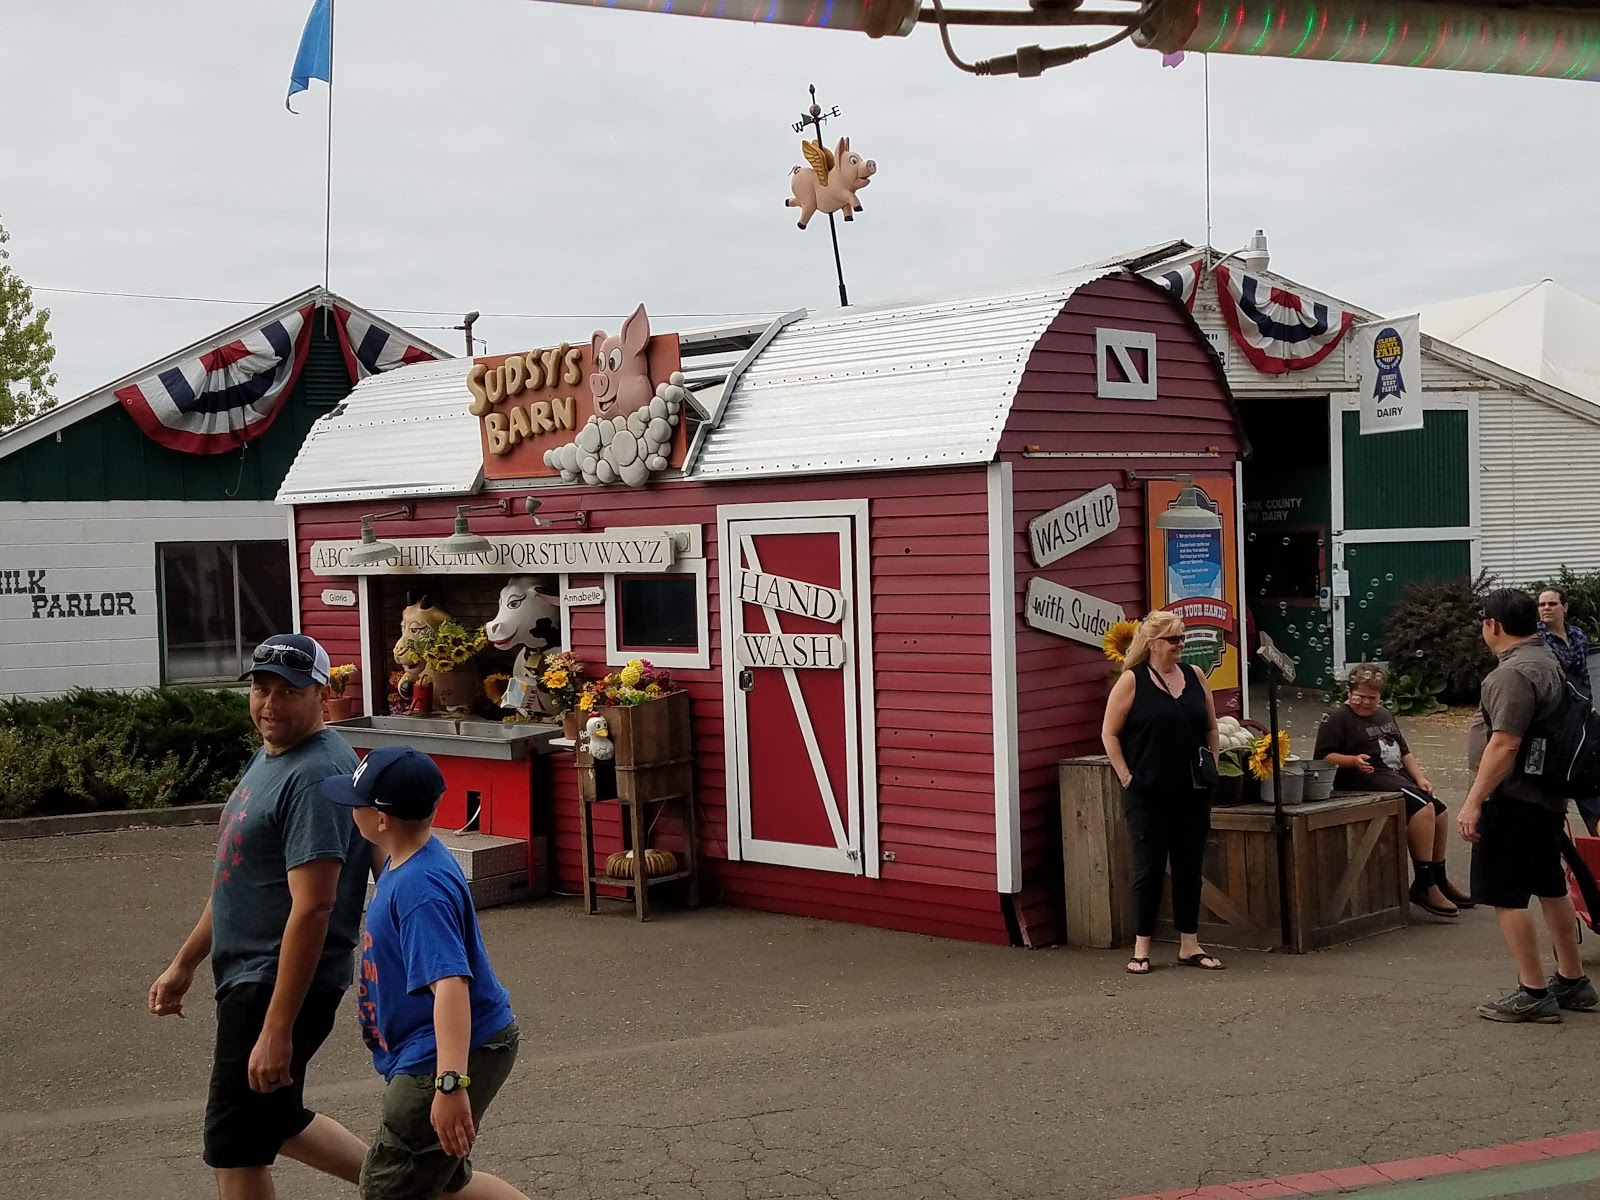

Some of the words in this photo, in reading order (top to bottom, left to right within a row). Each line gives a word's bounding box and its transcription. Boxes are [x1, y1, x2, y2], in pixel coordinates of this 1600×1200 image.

[1376, 341, 1398, 350] COUNTY
[1377, 336, 1397, 345] CLARK
[1376, 346, 1401, 358] FAIR
[466, 342, 582, 417] SUDSY'S
[1376, 406, 1403, 418] DAIRY
[485, 396, 577, 455] BARN
[1266, 497, 1302, 509] COUNTY
[1036, 505, 1089, 556] WASH
[1093, 494, 1114, 528] UP
[1262, 510, 1289, 521] DAIRY
[0, 569, 46, 595] ILK
[31, 591, 137, 618] PARLOR
[563, 591, 601, 602] Annabelle
[737, 570, 837, 620] HAND
[1032, 594, 1065, 624] with
[1184, 603, 1204, 618] YOUR
[1203, 603, 1228, 621] HANDS
[743, 635, 836, 667] WASH
[525, 688, 539, 710] MILK
